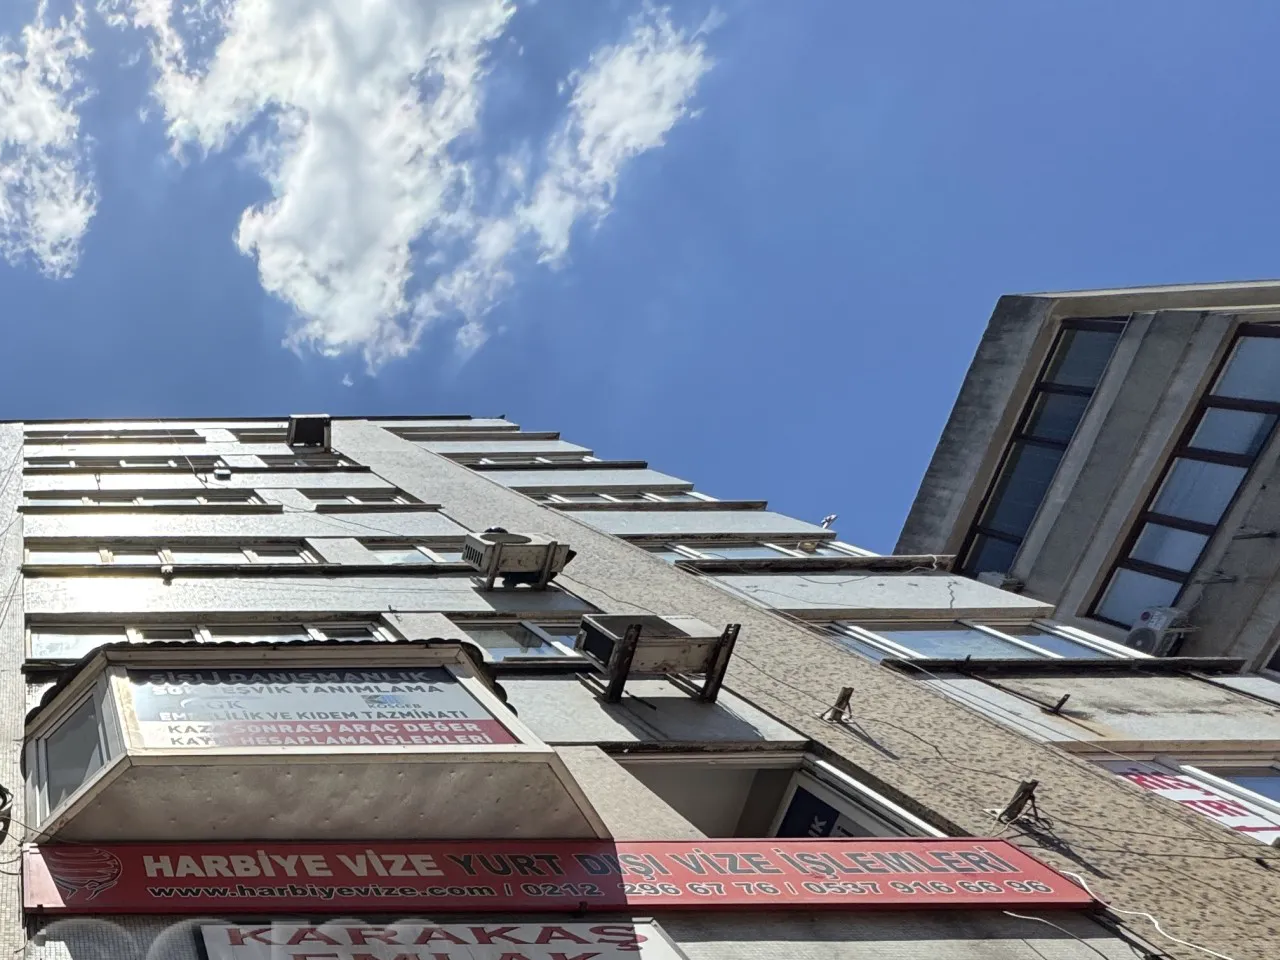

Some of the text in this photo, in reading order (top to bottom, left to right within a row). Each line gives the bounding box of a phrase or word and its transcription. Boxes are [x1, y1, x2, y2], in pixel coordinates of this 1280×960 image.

[295, 685, 445, 694] TANIMLAMA
[266, 711, 292, 720] VE
[296, 711, 358, 720] KIDEM
[360, 710, 469, 720] TAZMİNATI
[233, 724, 333, 734] SONRASI
[338, 723, 401, 734] ARAÇ
[403, 721, 483, 733] DEĞER
[241, 735, 373, 746] HESAPLAMA
[372, 733, 493, 746] İŞLEMLERİ
[144, 847, 1022, 882] HARBİYE VİZE YURT DIŞI VİZE İŞLEMLERİ
[147, 879, 1056, 900] www.harbiyevize.com 0212 296 67 76 0537 916 66 96
[226, 925, 649, 950] KARAKAŞ
